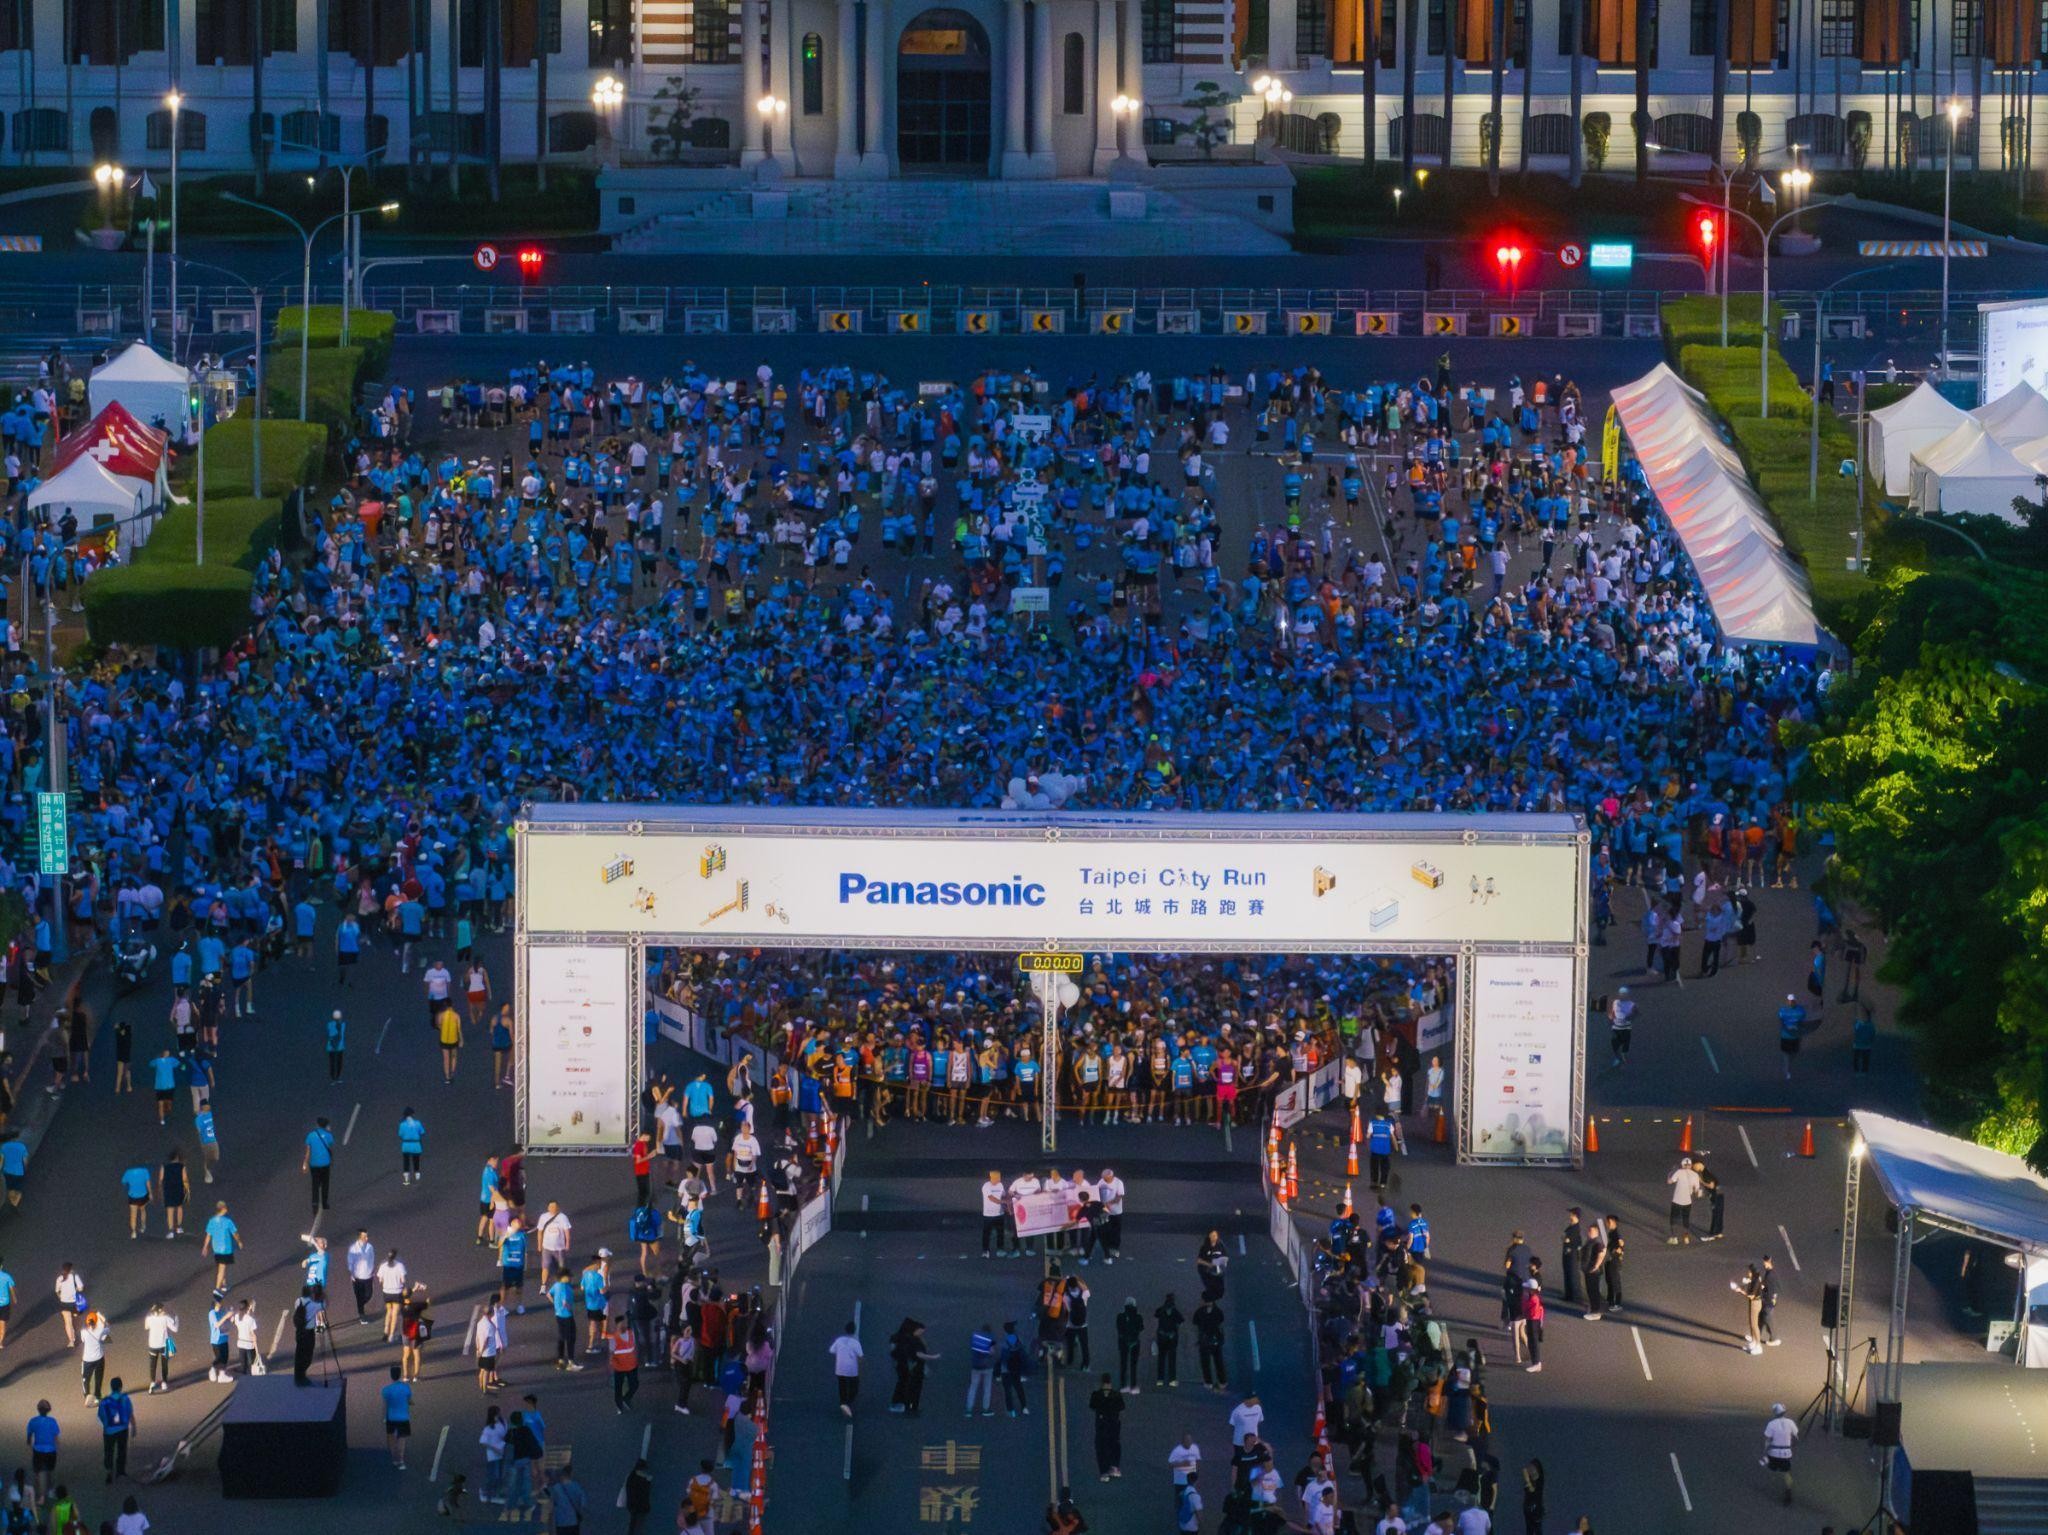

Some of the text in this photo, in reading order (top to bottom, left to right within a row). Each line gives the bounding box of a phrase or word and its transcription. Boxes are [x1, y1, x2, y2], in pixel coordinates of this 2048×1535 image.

[839, 872, 1047, 907] Panasonic
[1080, 868, 1266, 891] Taipei City Run
[1079, 898, 1265, 916] 台北城市路跑賽
